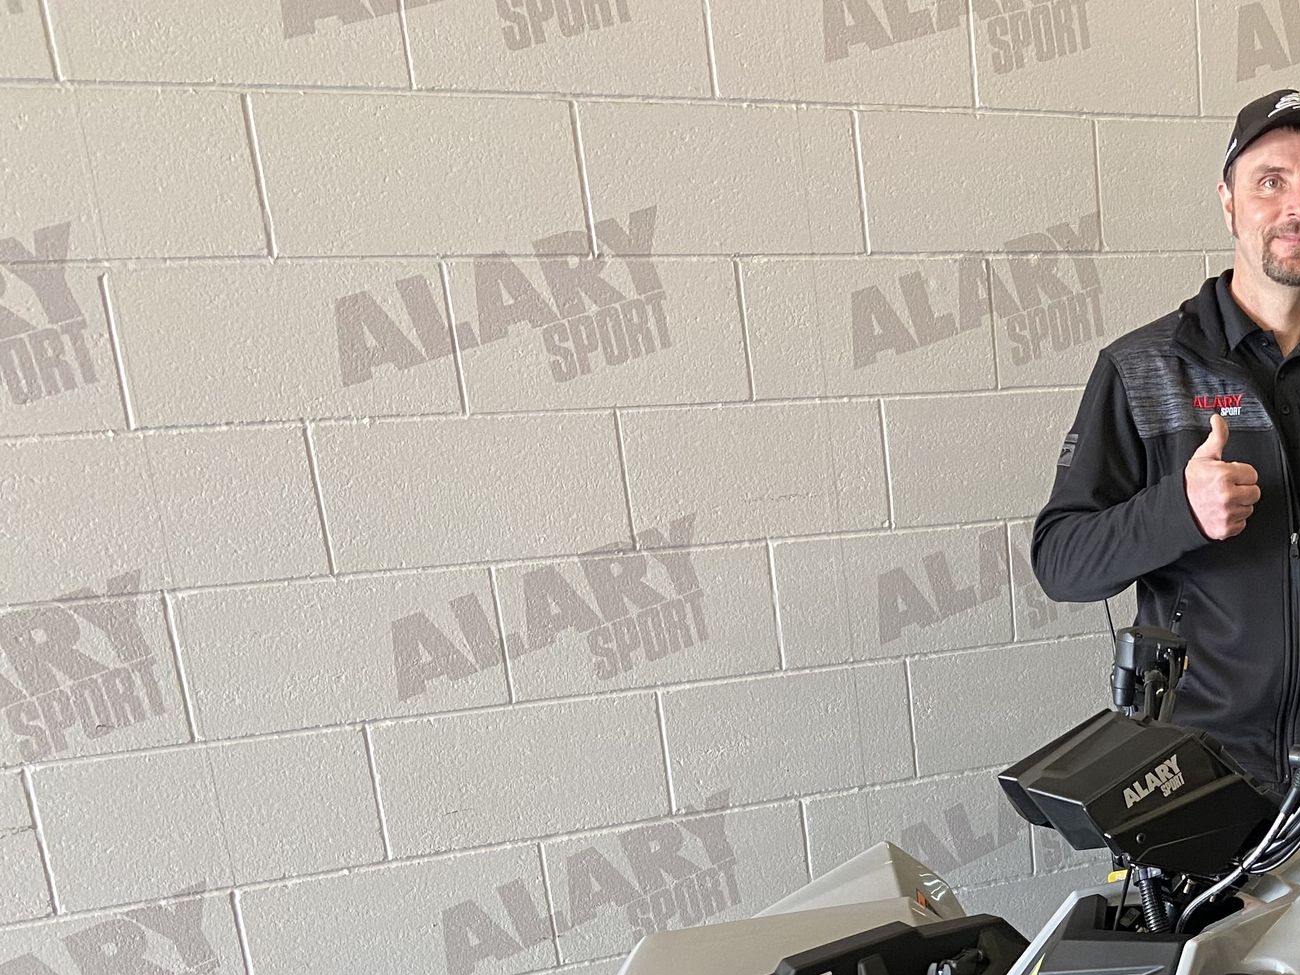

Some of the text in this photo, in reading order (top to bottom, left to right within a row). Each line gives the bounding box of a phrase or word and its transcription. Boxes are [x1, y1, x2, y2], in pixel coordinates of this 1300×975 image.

[334, 205, 667, 388] ALARY
[541, 290, 673, 384] SPORT
[850, 211, 1101, 370] ALARY
[1006, 286, 1105, 367] SPORT
[1192, 393, 1245, 409] ALARY
[1220, 406, 1243, 417] SPORT
[391, 511, 702, 702] ALARY
[587, 588, 709, 681] SPORT
[5, 653, 166, 763] SPORT
[1123, 754, 1181, 809] ALARY
[1160, 771, 1185, 797] SPORT
